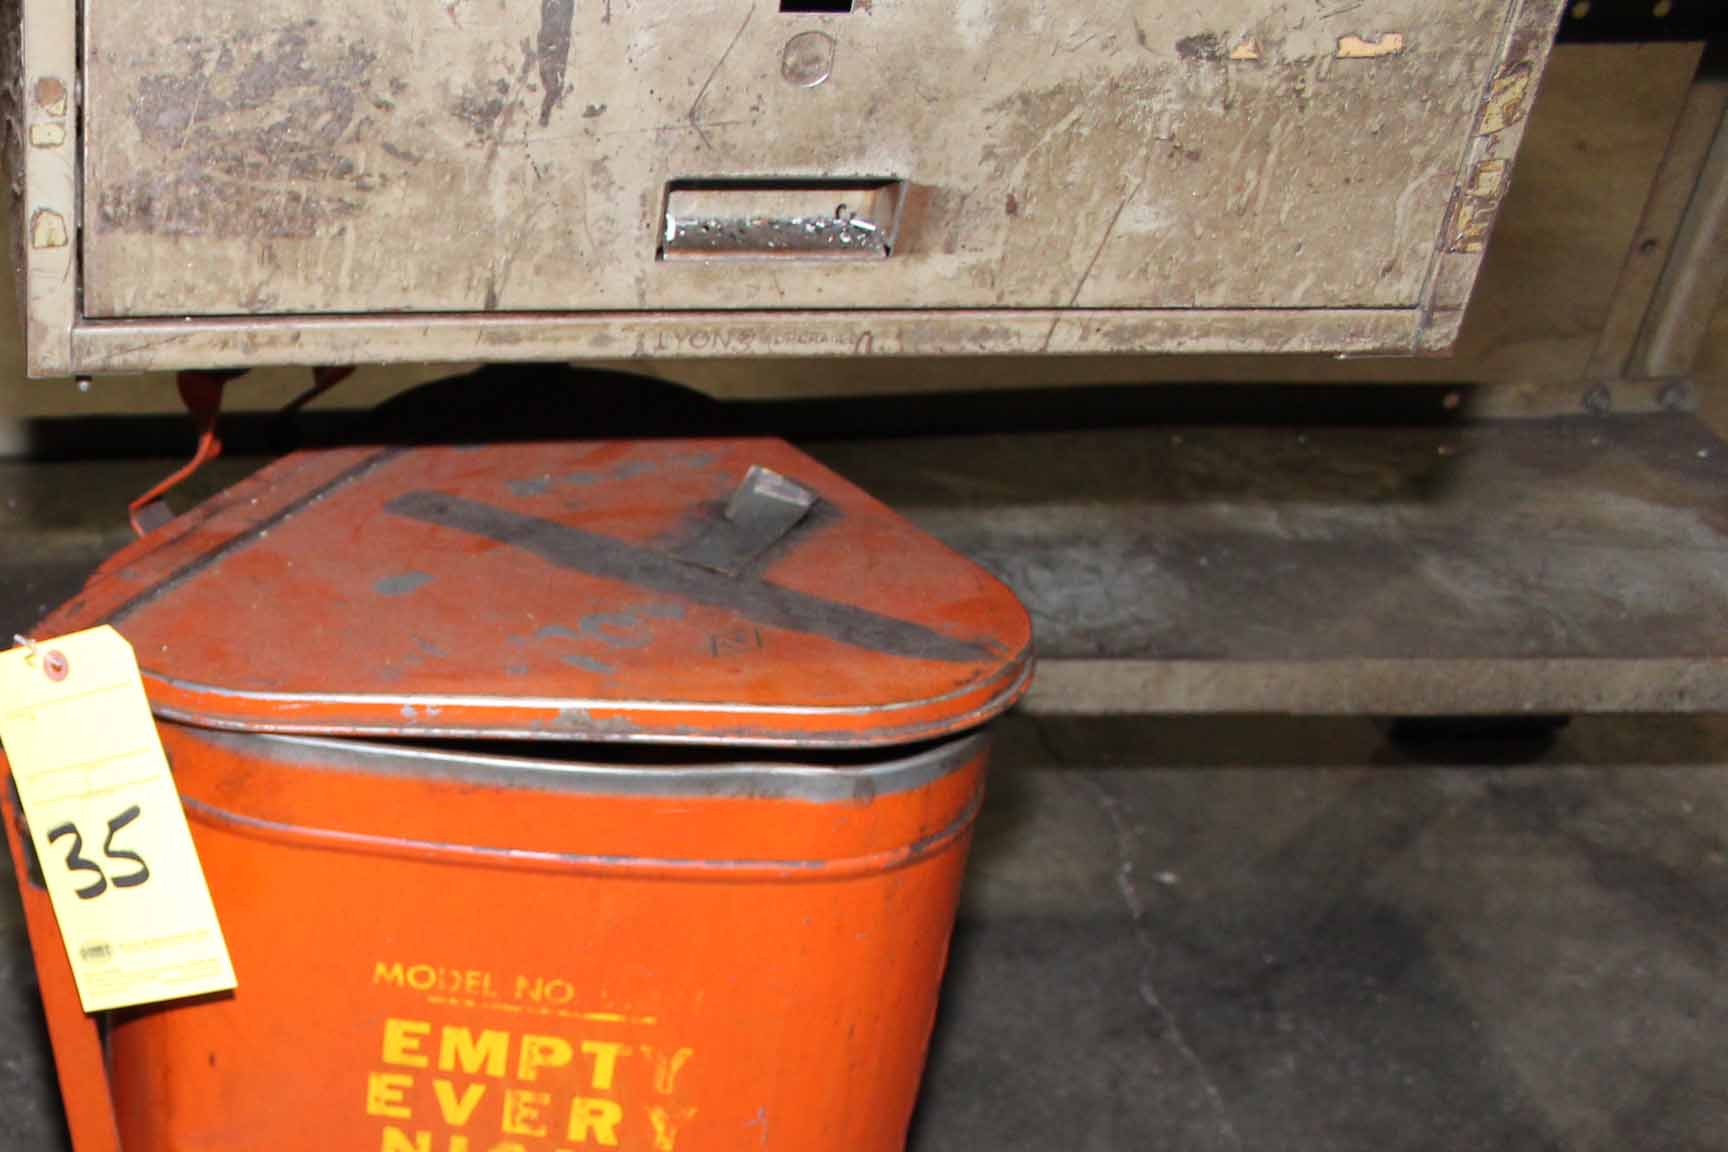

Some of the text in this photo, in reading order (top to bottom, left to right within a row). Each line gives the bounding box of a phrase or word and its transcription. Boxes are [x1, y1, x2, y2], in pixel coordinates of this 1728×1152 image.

[48, 805, 149, 899] 35
[373, 961, 497, 997] MODEL
[382, 1018, 693, 1094] EMPTY
[367, 1071, 697, 1152] EVERY
